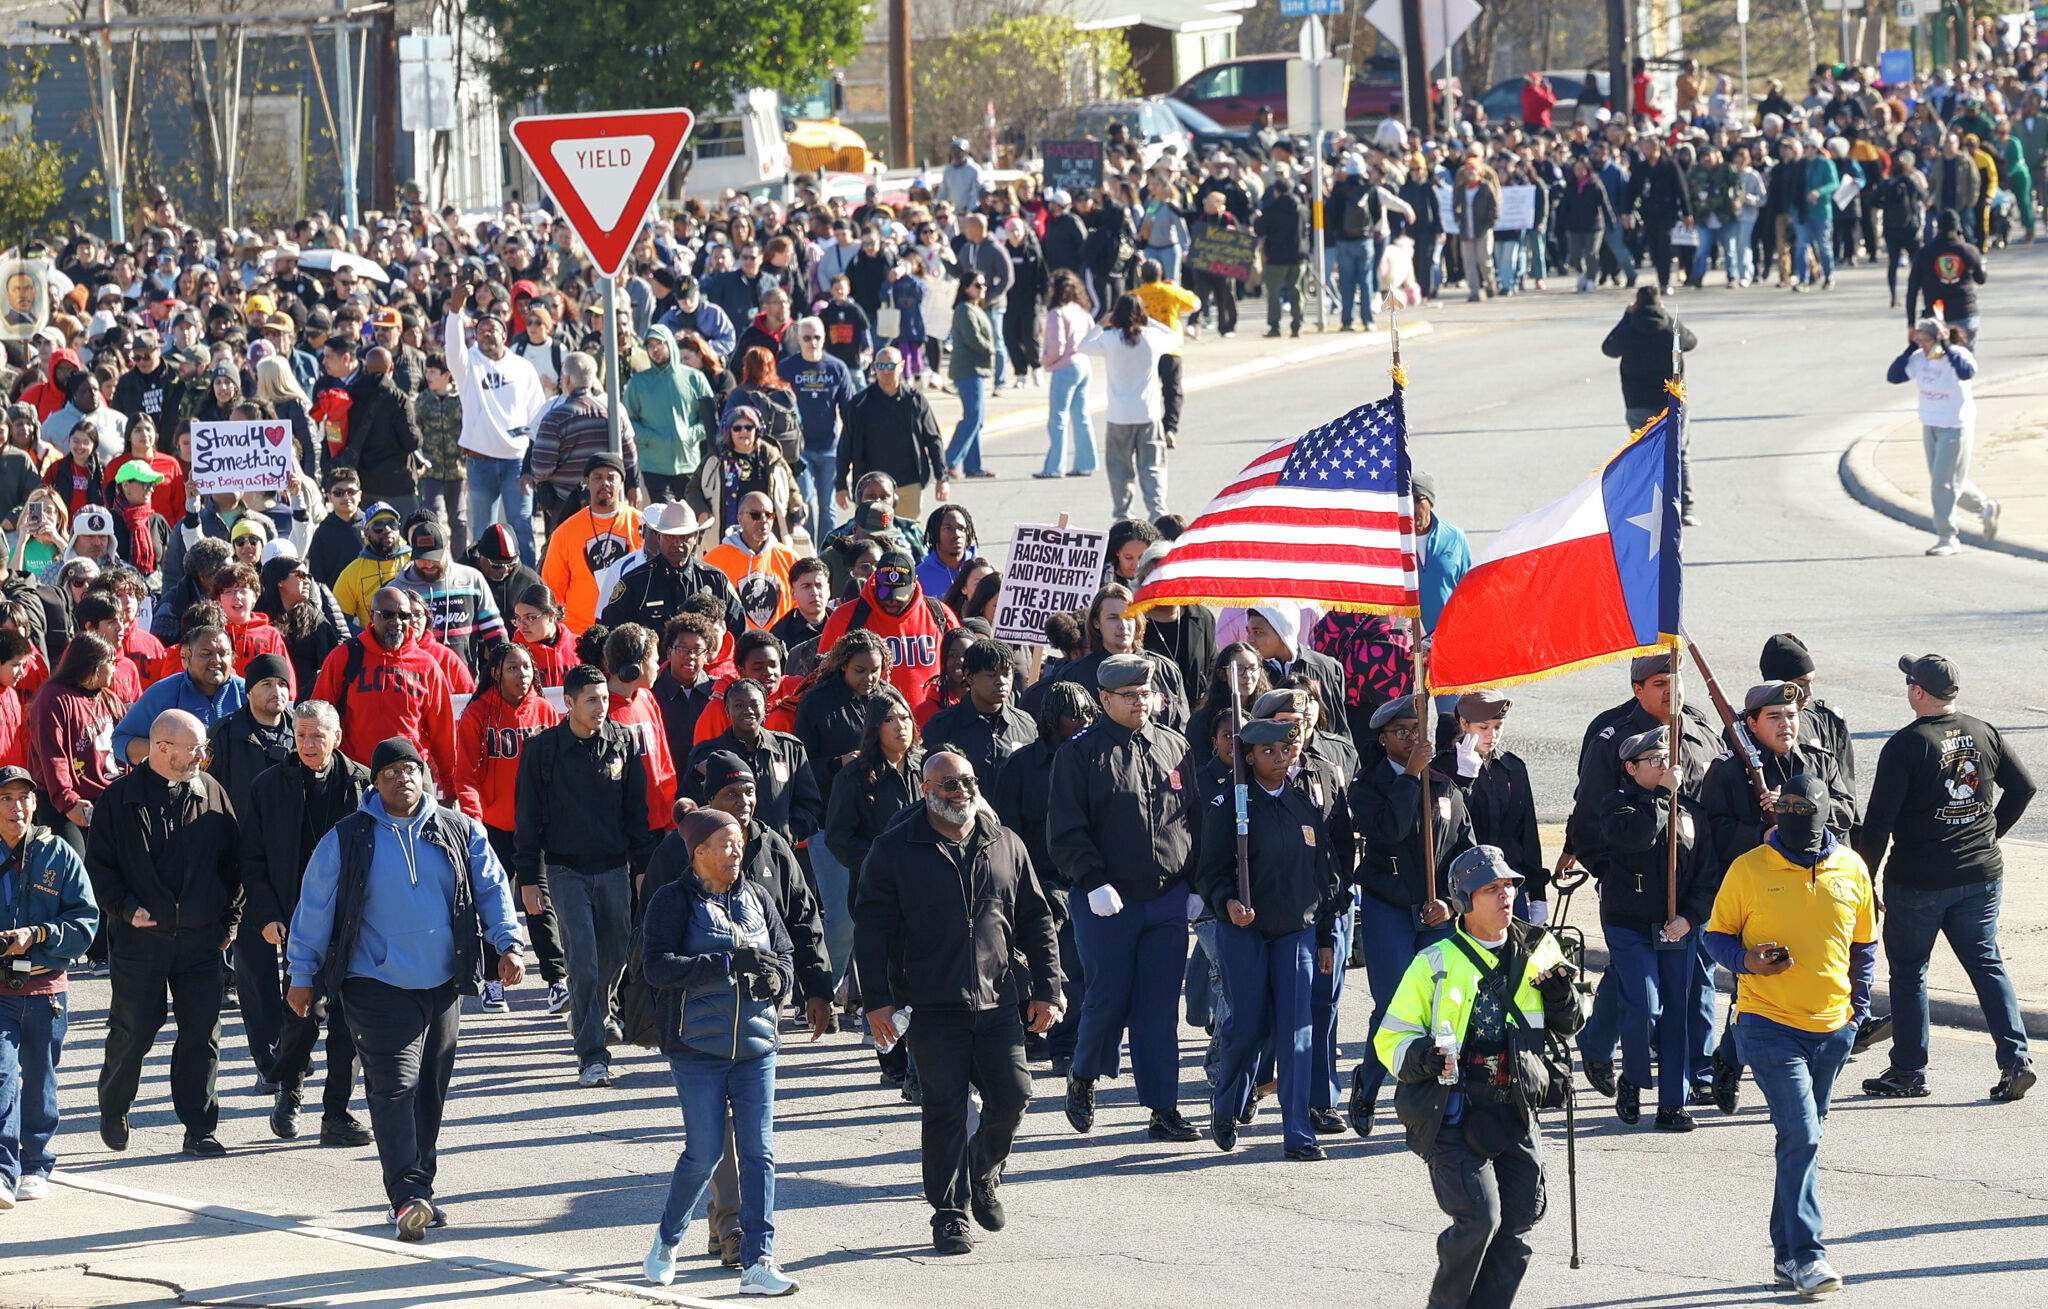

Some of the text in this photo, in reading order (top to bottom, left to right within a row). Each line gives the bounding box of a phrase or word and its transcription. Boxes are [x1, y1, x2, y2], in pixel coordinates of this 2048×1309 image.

[576, 149, 631, 169] YIELD
[795, 374, 834, 385] DREAM
[196, 425, 250, 451] Stand
[194, 449, 286, 478] Something
[1017, 527, 1103, 549] FIGHT
[1013, 543, 1099, 569] RACISM, WAR
[1008, 562, 1094, 588] AND POVERTY:
[1039, 589, 1051, 610] 3
[1050, 591, 1092, 612] EVILS
[999, 606, 1020, 628] OF
[995, 630, 1012, 638] PARTY
[887, 635, 936, 666] OTC
[1941, 735, 1974, 754] JROTC
